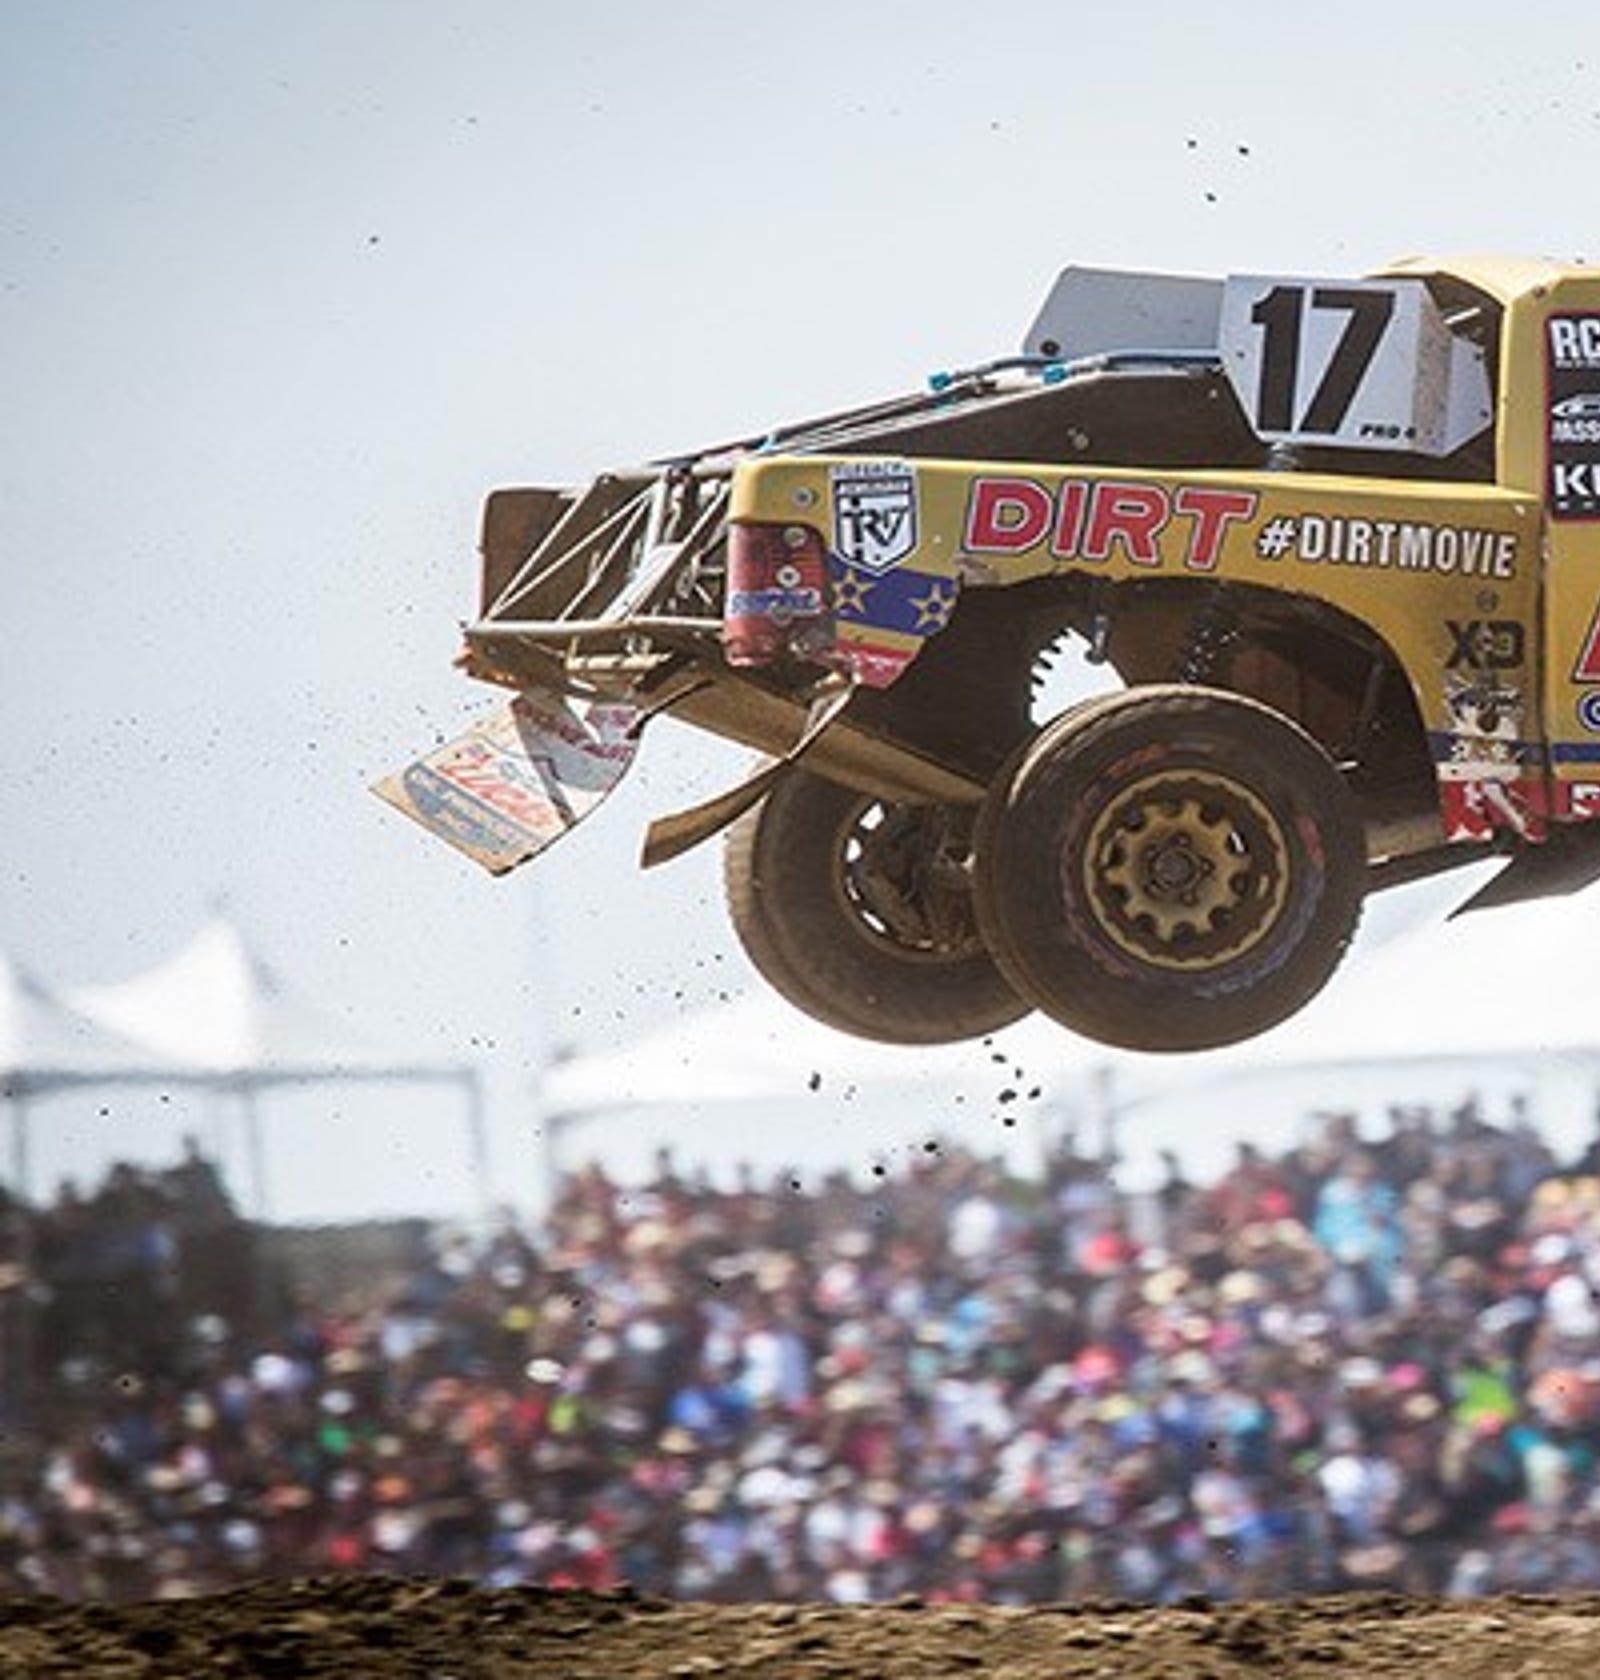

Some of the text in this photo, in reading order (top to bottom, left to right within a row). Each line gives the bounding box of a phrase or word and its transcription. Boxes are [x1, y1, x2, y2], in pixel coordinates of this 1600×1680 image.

[1251, 286, 1397, 434] 17
[1359, 423, 1400, 439] PRO
[965, 477, 1518, 578] DIRT #DIRTMOVIE
